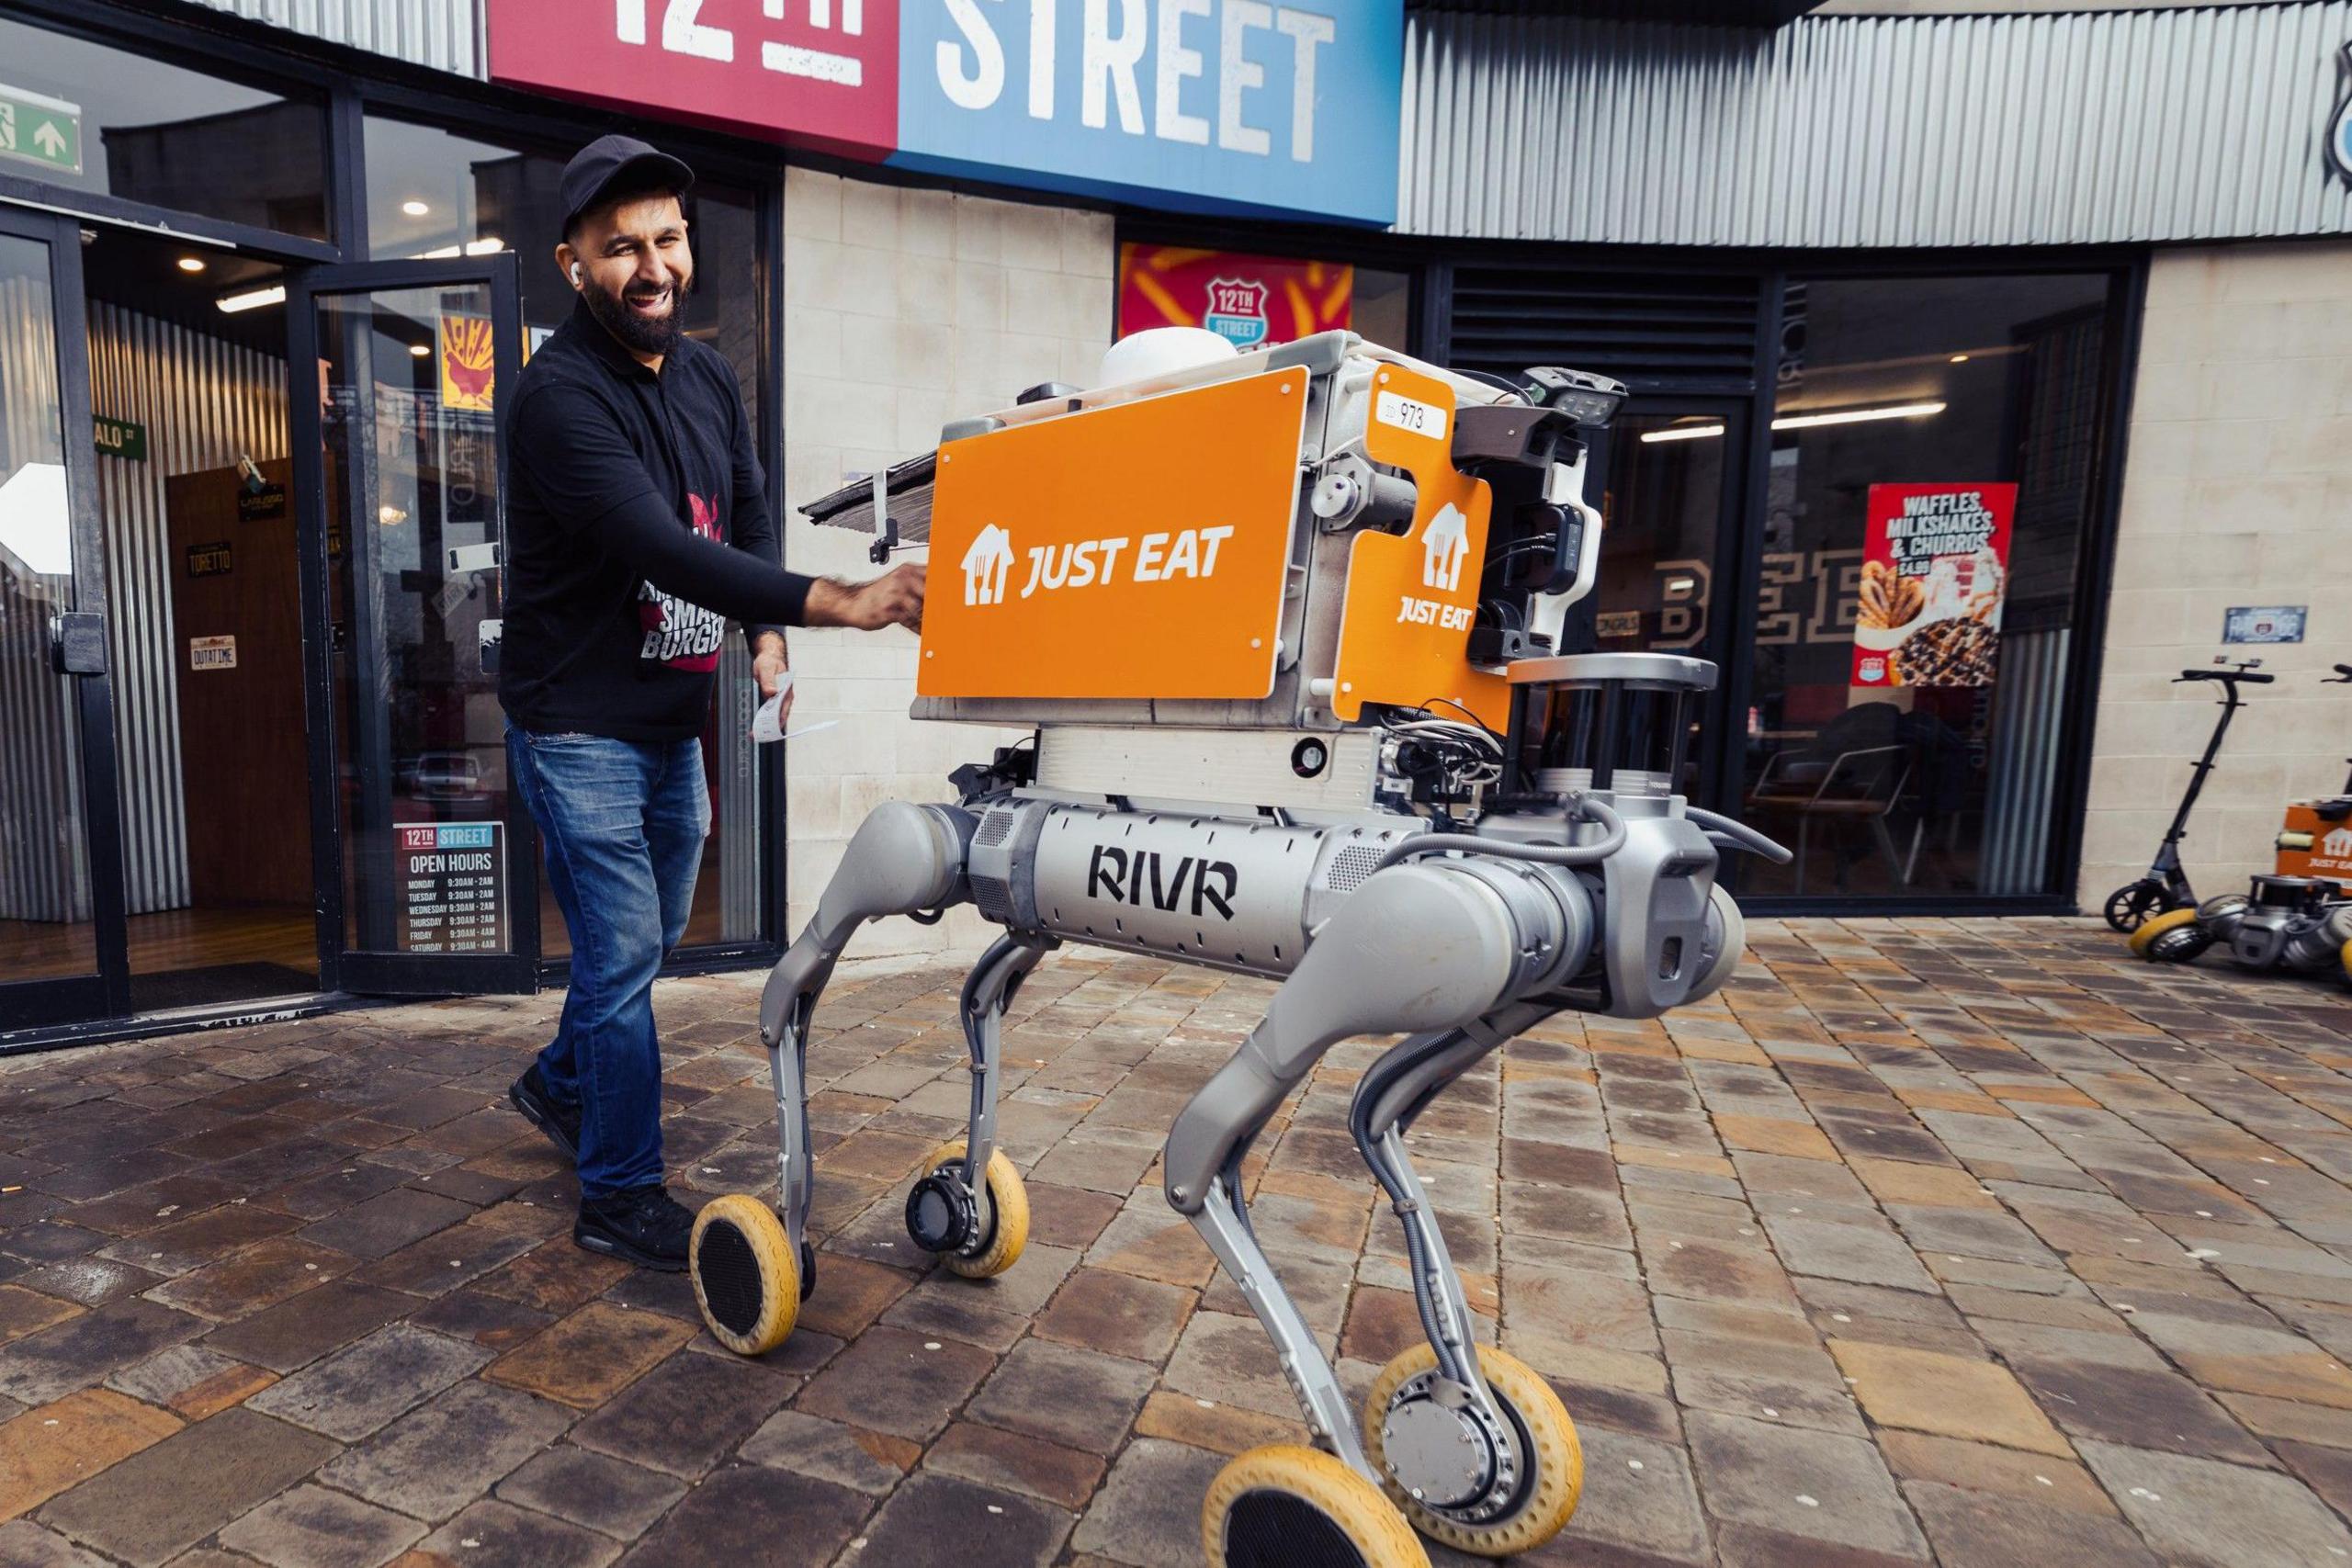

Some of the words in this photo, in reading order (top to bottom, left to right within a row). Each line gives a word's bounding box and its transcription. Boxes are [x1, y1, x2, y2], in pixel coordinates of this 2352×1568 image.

[936, 0, 1336, 163] STREET
[1218, 289, 1254, 313] 12TH
[1215, 319, 1258, 337] STREET
[1401, 402, 1424, 429] 973
[1904, 492, 1984, 516] WAFFLES,
[1886, 512, 1996, 539] MILKSHAKES,
[1890, 538, 1905, 558] &
[1910, 533, 1988, 557] CHURROS
[1021, 537, 1129, 599] JUST
[1133, 525, 1235, 582] EAT
[1396, 595, 1442, 626] JUST
[1440, 604, 1473, 632] EAT
[194, 648, 233, 665] OUTATIME
[406, 829, 434, 845] 12TH
[440, 829, 487, 845] STREET
[410, 855, 445, 874] OPEN
[448, 852, 492, 872] HOURS
[408, 879, 435, 889] MONDAY
[447, 877, 474, 887] 9:30AM
[479, 876, 493, 886] 2AM
[1088, 844, 1235, 922] RIVR
[408, 892, 437, 902] TUESDAY
[447, 890, 474, 900] 9:30AM
[479, 889, 494, 898] 2AM
[409, 904, 447, 915] WEDNESDAY
[449, 903, 475, 913] 9:30AM
[480, 901, 495, 911] 2AM
[410, 918, 443, 928] THURSDAY
[449, 916, 475, 926] 9:30AM
[481, 914, 495, 923] 2AM
[410, 931, 433, 941] FRIDAY
[450, 929, 476, 939] 9:30AM
[481, 927, 495, 936] 4AM
[410, 942, 442, 953] SATURDAY
[450, 942, 476, 952] 9:30AM
[481, 940, 496, 949] 4AM
